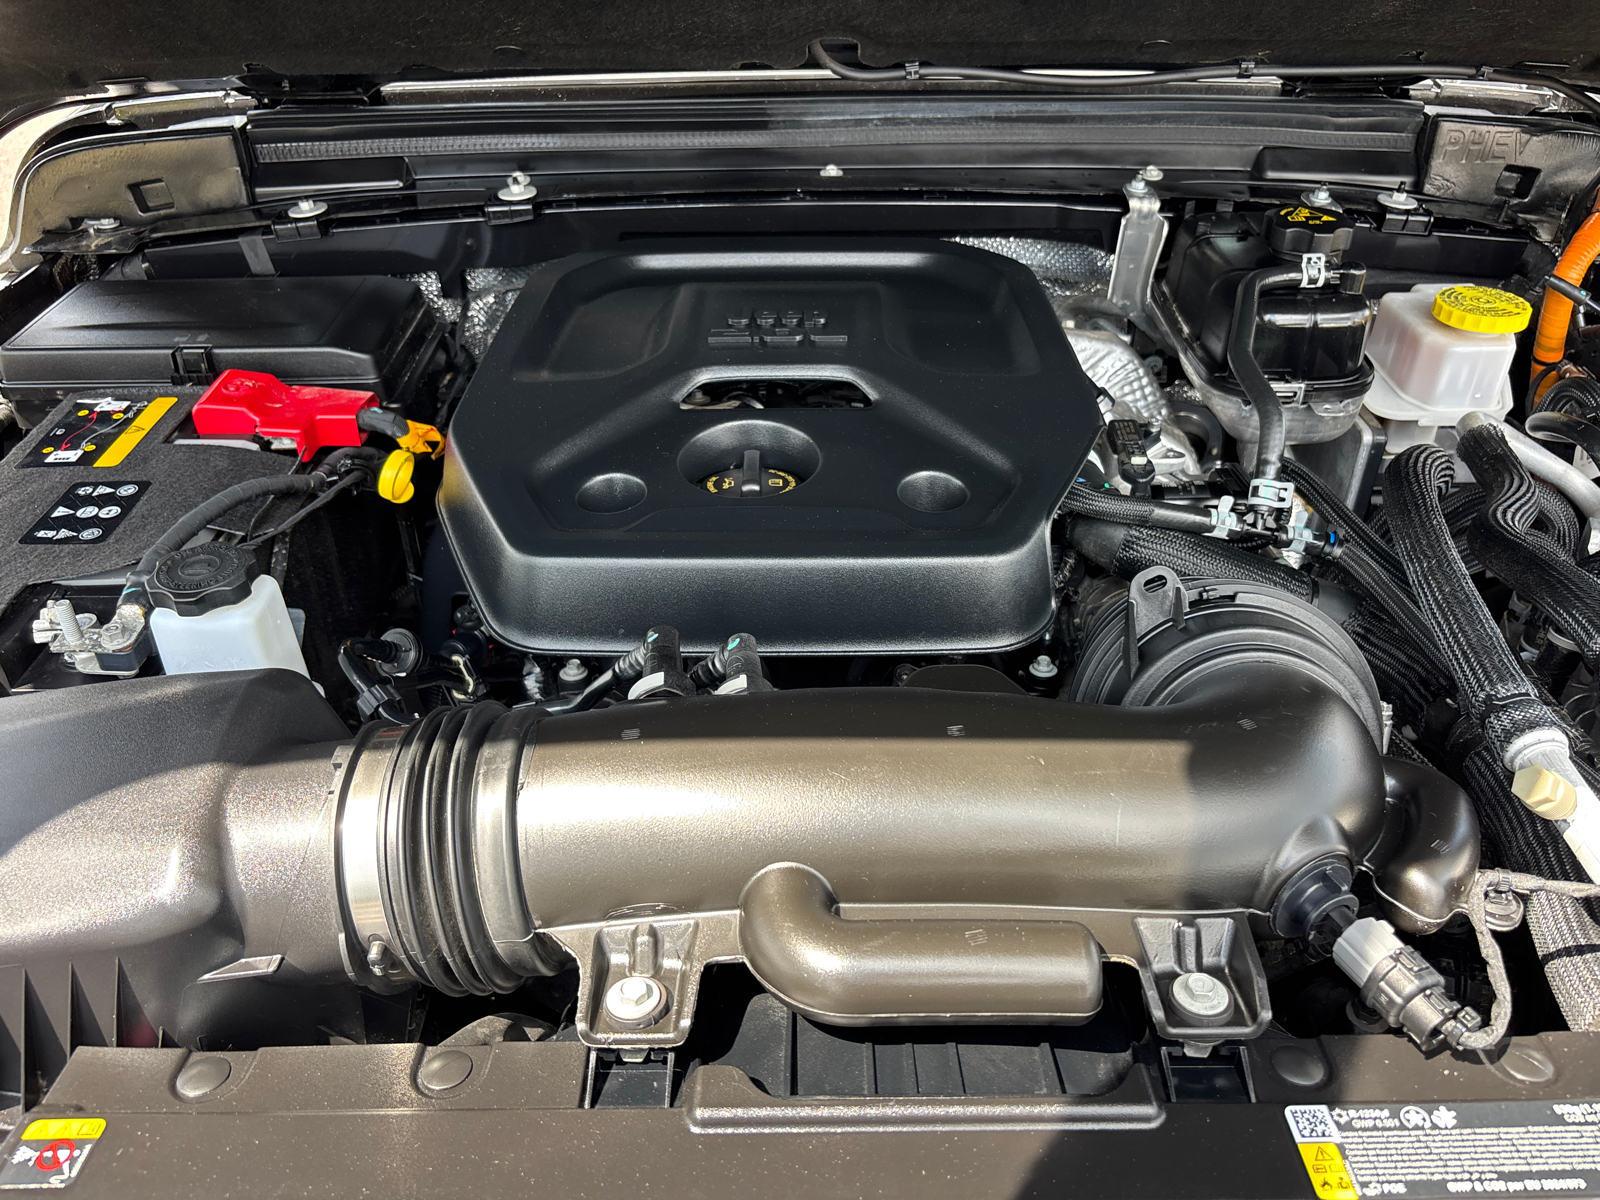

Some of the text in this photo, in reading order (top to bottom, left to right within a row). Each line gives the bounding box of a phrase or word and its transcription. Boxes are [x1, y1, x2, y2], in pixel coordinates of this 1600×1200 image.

[1437, 129, 1532, 164] PHEV
[726, 307, 829, 328] Jeep
[1352, 1118, 1375, 1128] GWP
